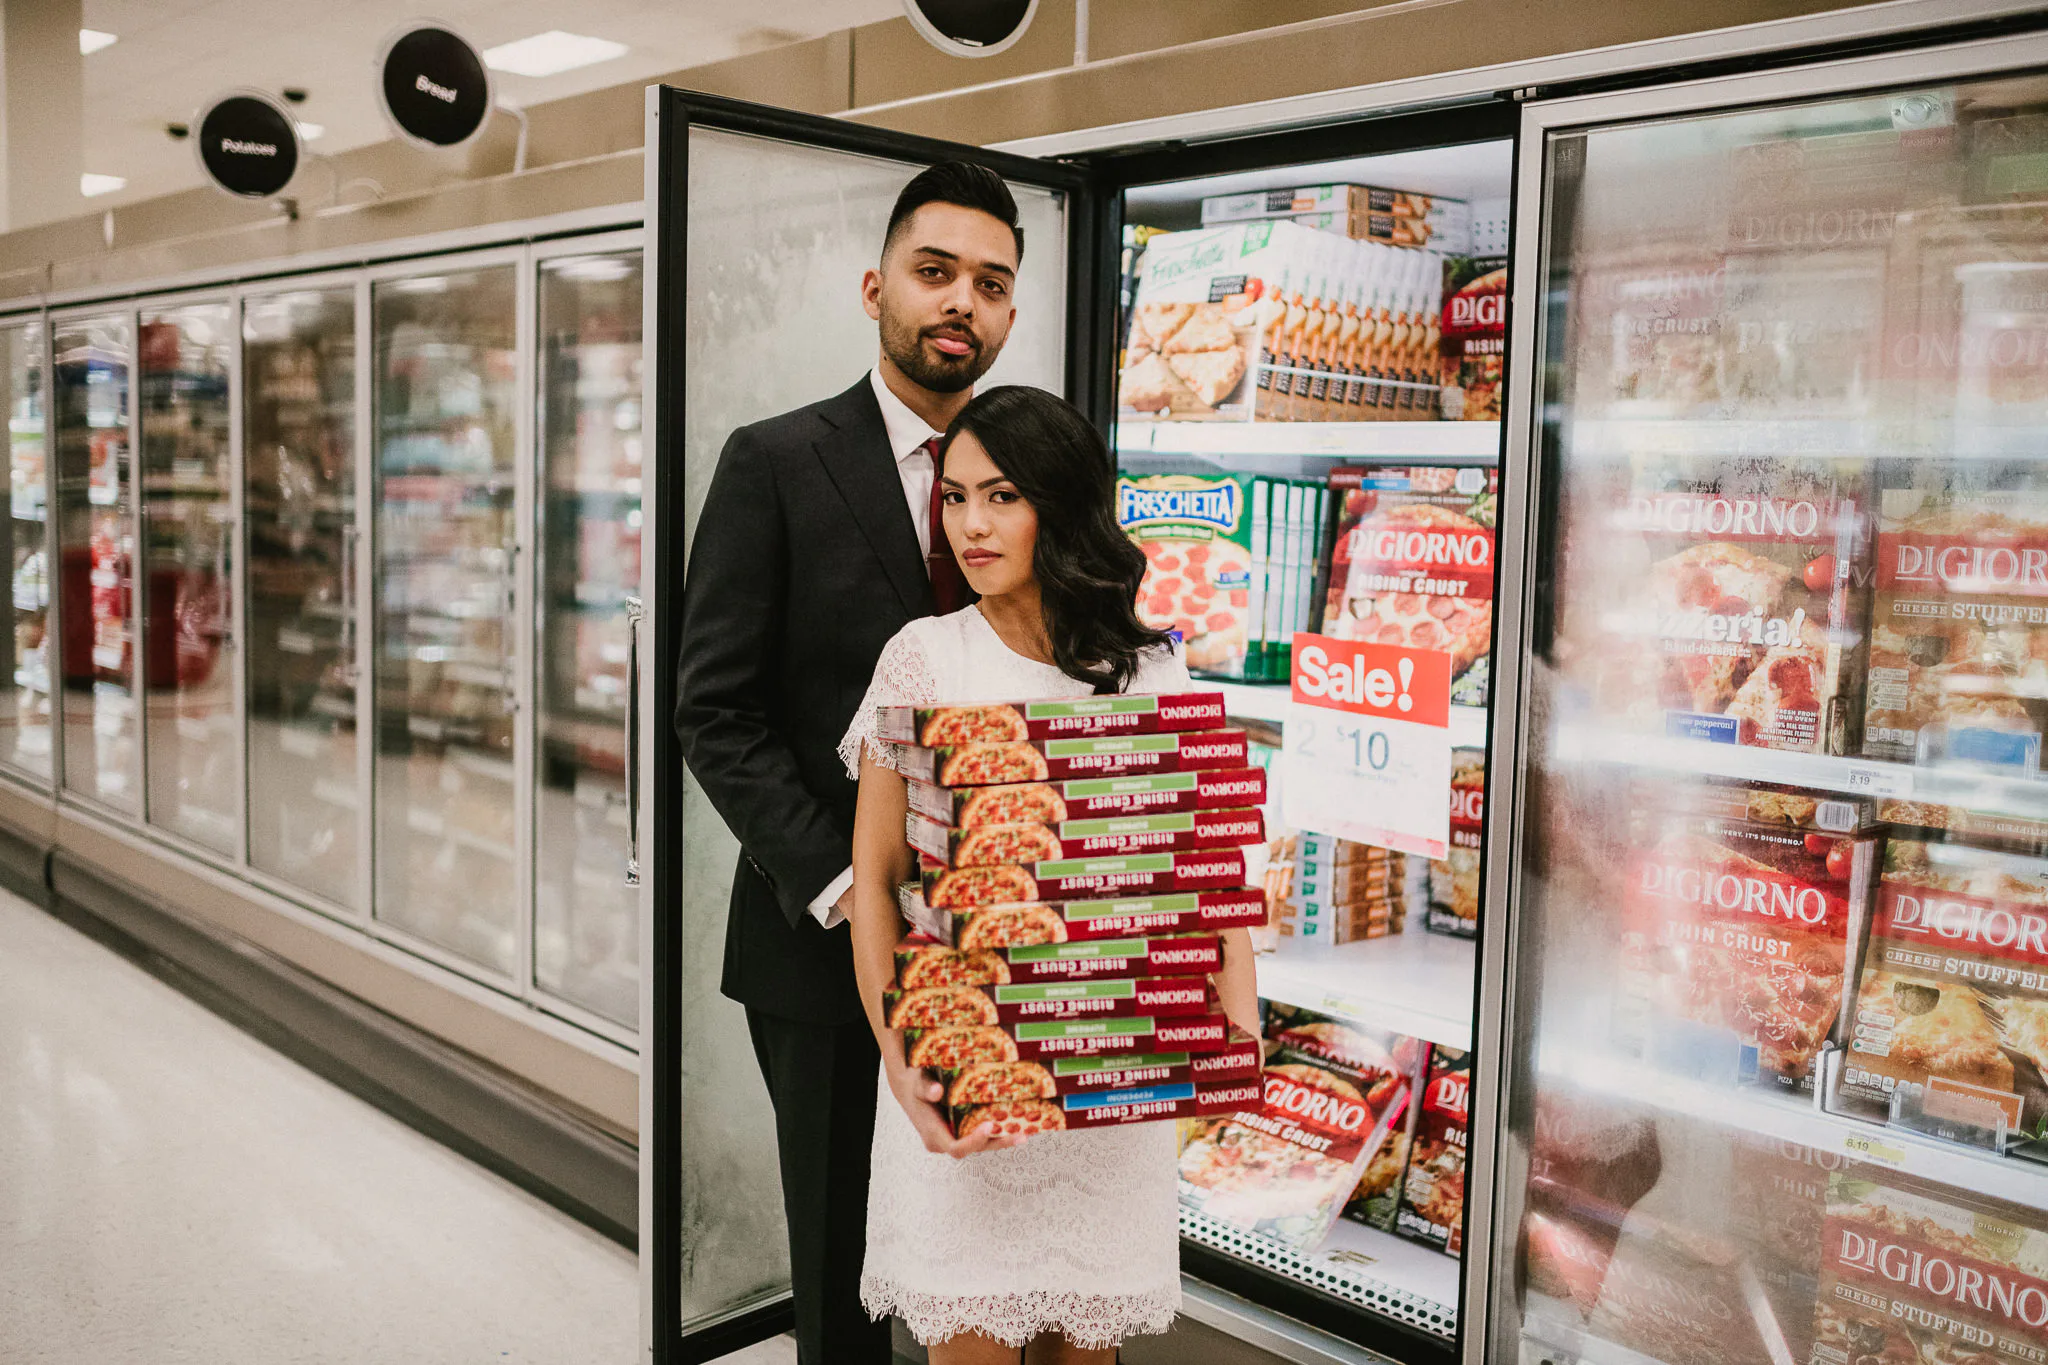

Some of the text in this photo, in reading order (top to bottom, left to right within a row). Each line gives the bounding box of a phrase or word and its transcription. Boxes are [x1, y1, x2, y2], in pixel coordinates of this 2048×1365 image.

[416, 74, 457, 104] Bread
[221, 138, 277, 157] Potatoes
[1744, 208, 1897, 249] DIGIORN
[1654, 318, 1711, 334] CRUST
[1121, 486, 1233, 526] FRESCHETTA
[1346, 529, 1489, 566] DIGIORNO
[1357, 573, 1469, 596] RISING CRUST
[1893, 602, 1948, 616] CHEESE
[1297, 645, 1414, 713] Sale!
[1161, 703, 1222, 719] DIGIORNO
[1775, 708, 1797, 716] FRESH
[1776, 714, 1816, 724] YOUR OVEN!
[1049, 715, 1138, 730] RISING CRUST
[1694, 719, 1734, 731] pepperoni
[1181, 743, 1243, 760] DIGIORNO
[1068, 754, 1159, 768] RISING CRUST
[1850, 774, 1870, 785] 8.19
[1199, 780, 1261, 798] DIGIORNO
[1087, 792, 1178, 809] RISING CRUST
[1197, 820, 1259, 837] DIGIORNO
[1745, 832, 1759, 840] IT'S
[1083, 836, 1126, 849] CRUST
[1130, 833, 1174, 844] RISING
[1176, 861, 1240, 878] DIGIORNO
[1060, 877, 1103, 889] CRUST
[1107, 873, 1153, 885] RISING
[1641, 863, 1827, 926] DIGIORNO
[1201, 902, 1262, 919] DIGIORNO
[1088, 917, 1131, 931] CRUST
[1134, 913, 1179, 926] RISING
[1711, 919, 1747, 932] original
[1667, 921, 1791, 958] THIN CRUST
[1151, 948, 1216, 965] DIGIORNO
[1886, 949, 1941, 967] CHEESE
[1032, 959, 1127, 973] RISING CRUST
[1068, 999, 1114, 1011] RISING
[1138, 989, 1204, 1005] DIGIORNO
[1019, 1002, 1064, 1014] CRUST
[1158, 1026, 1223, 1041] DIGIORNO
[1040, 1039, 1083, 1051] CRUST
[1088, 1036, 1134, 1048] RISING
[1192, 1054, 1255, 1071] DIGIORNO
[1077, 1068, 1169, 1085] RISING CRUST
[1778, 1075, 1793, 1085] PIZZA
[1107, 1091, 1153, 1102] PEPPERONI
[1197, 1087, 1259, 1104] DIGIORNO
[1086, 1101, 1176, 1119] RISING CRUST
[1265, 1079, 1365, 1131] GIORNO
[1232, 1111, 1282, 1135] RISING
[1281, 1126, 1333, 1152] CRUST
[1846, 1138, 1869, 1152] 8.19
[1773, 1175, 1816, 1200] THIN
[1838, 1230, 2048, 1327] DIGIORNO
[1835, 1285, 2046, 1362] CHEESE STUFFED CRUST
